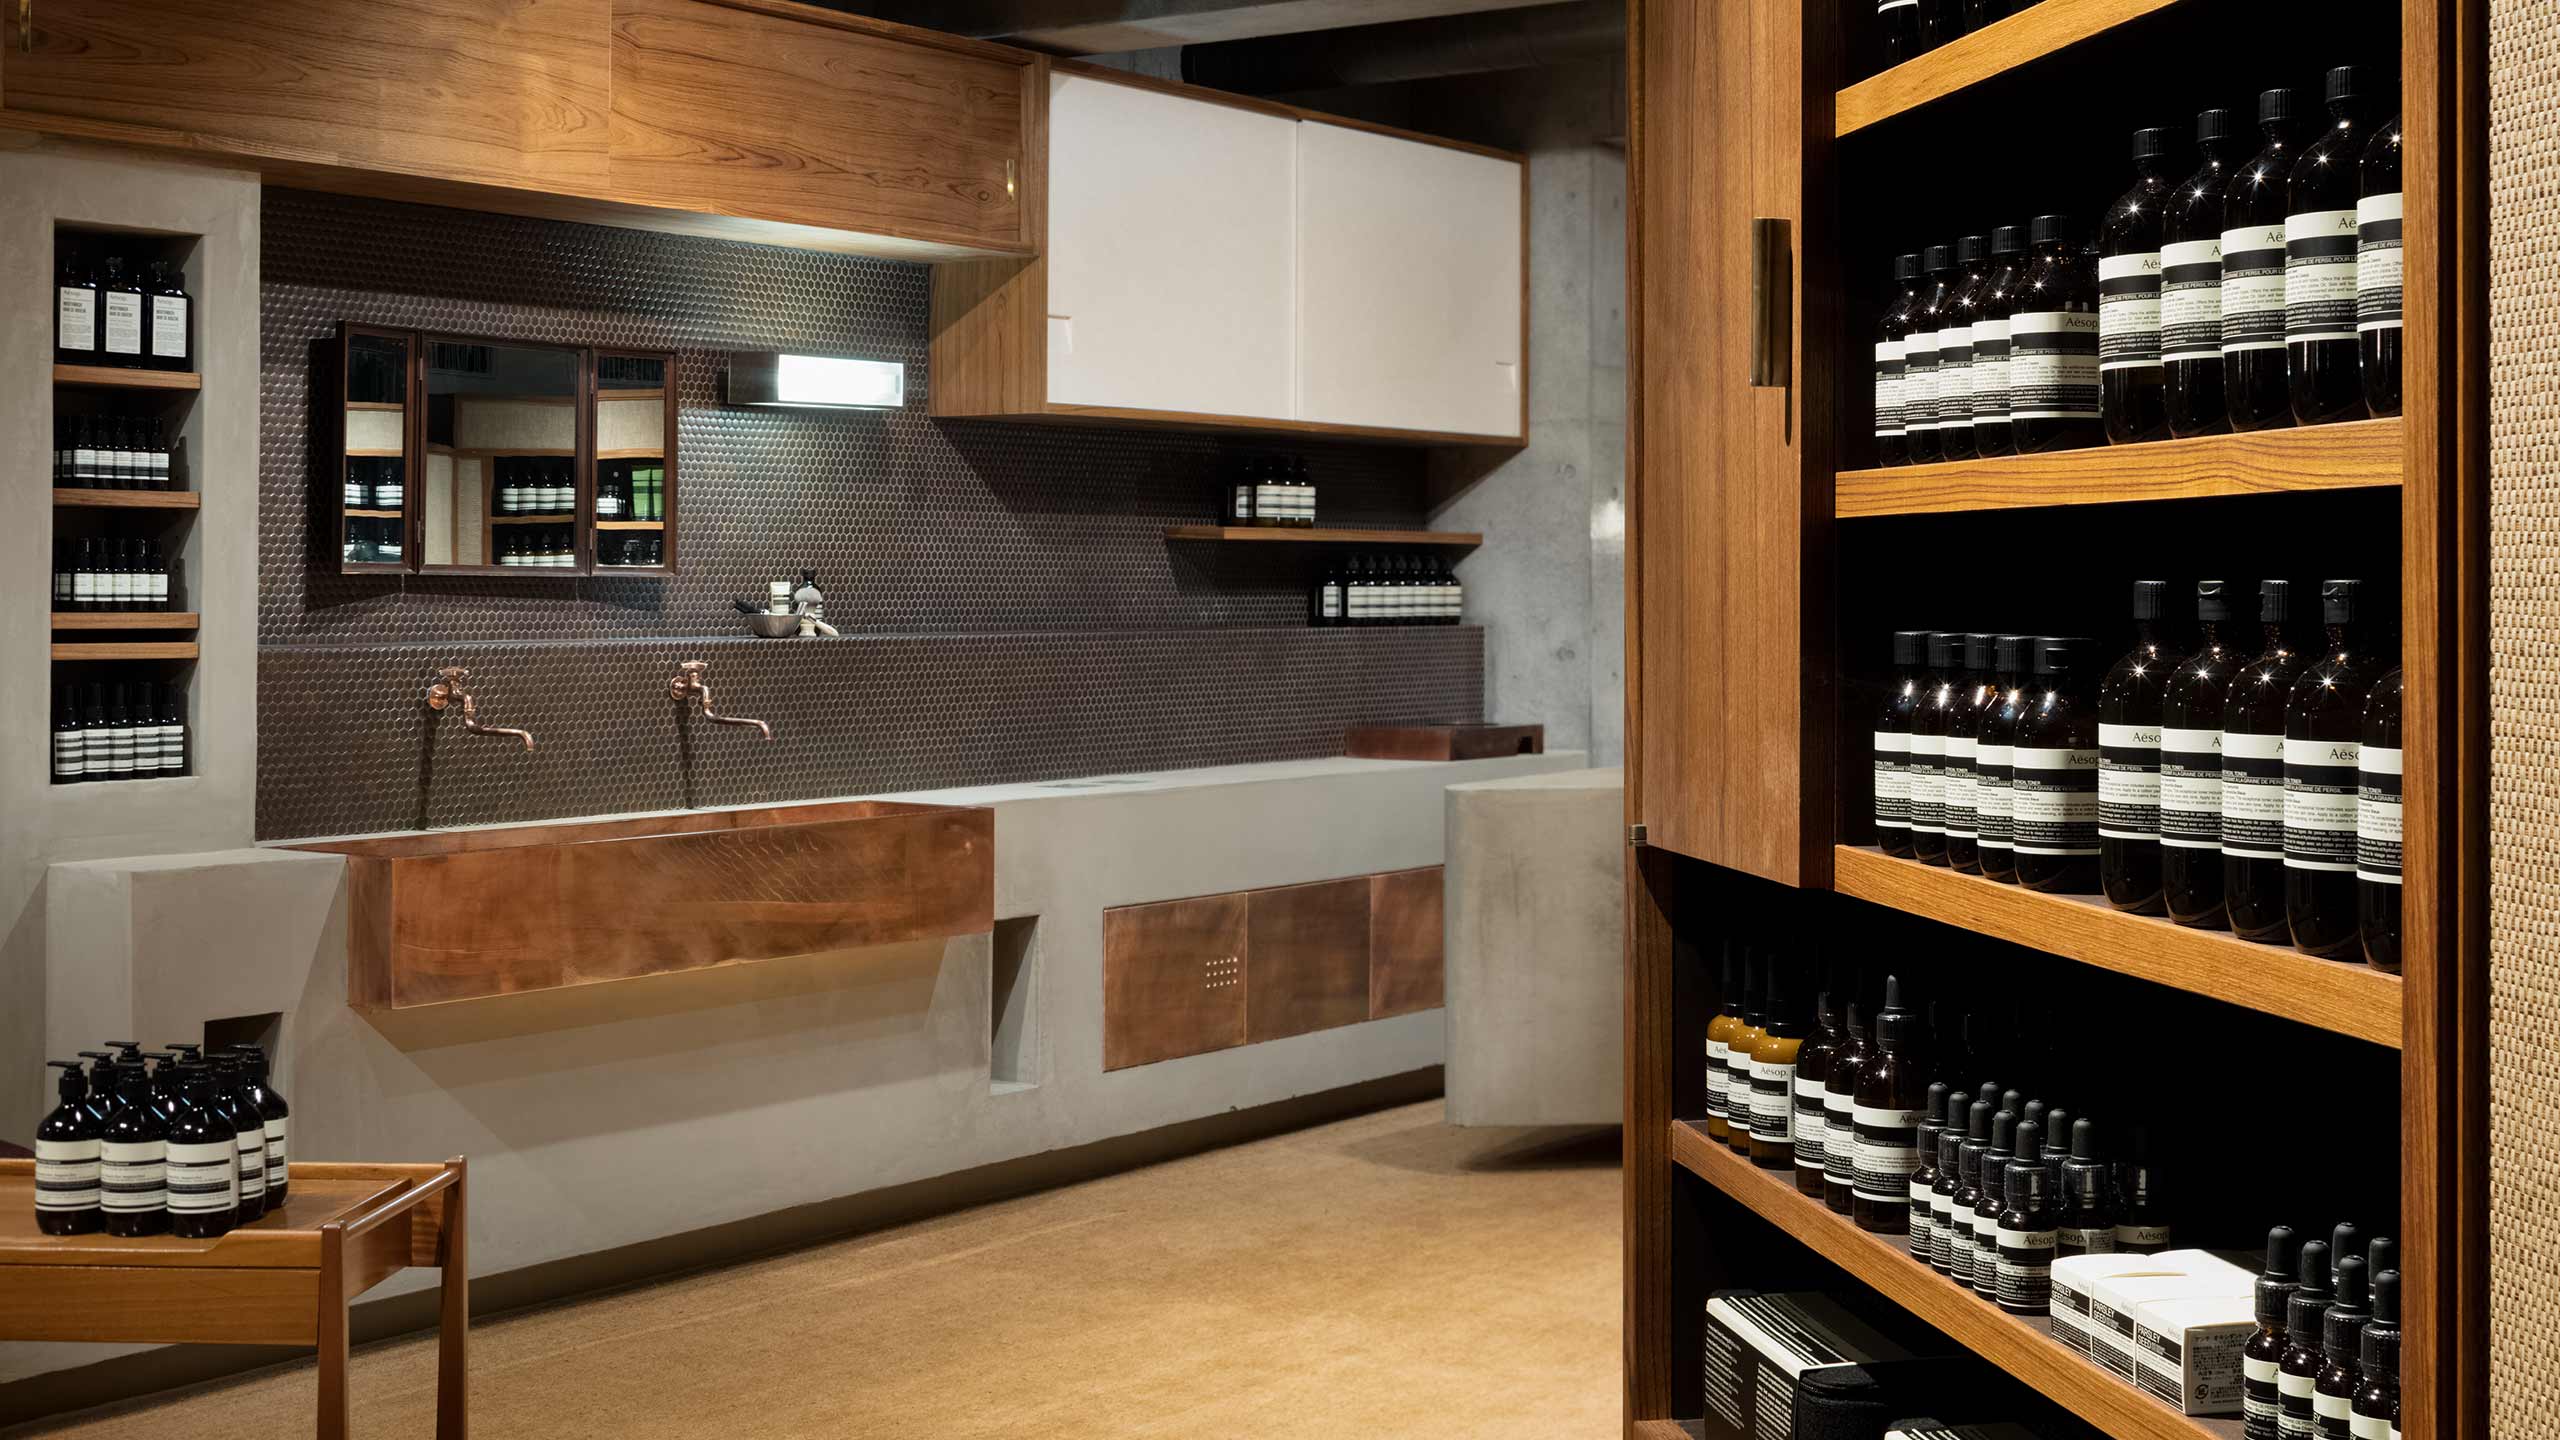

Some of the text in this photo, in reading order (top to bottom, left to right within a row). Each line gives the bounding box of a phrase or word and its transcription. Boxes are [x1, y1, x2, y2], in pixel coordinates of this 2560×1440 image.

[2051, 1280, 2072, 1297] PARSLEY
[2051, 1290, 2064, 1303] SEED
[2094, 1300, 2115, 1319] PARSLEY
[2094, 1311, 2107, 1324] SEED
[2137, 1324, 2161, 1344] PARSLEY
[2137, 1334, 2152, 1350] SEED
